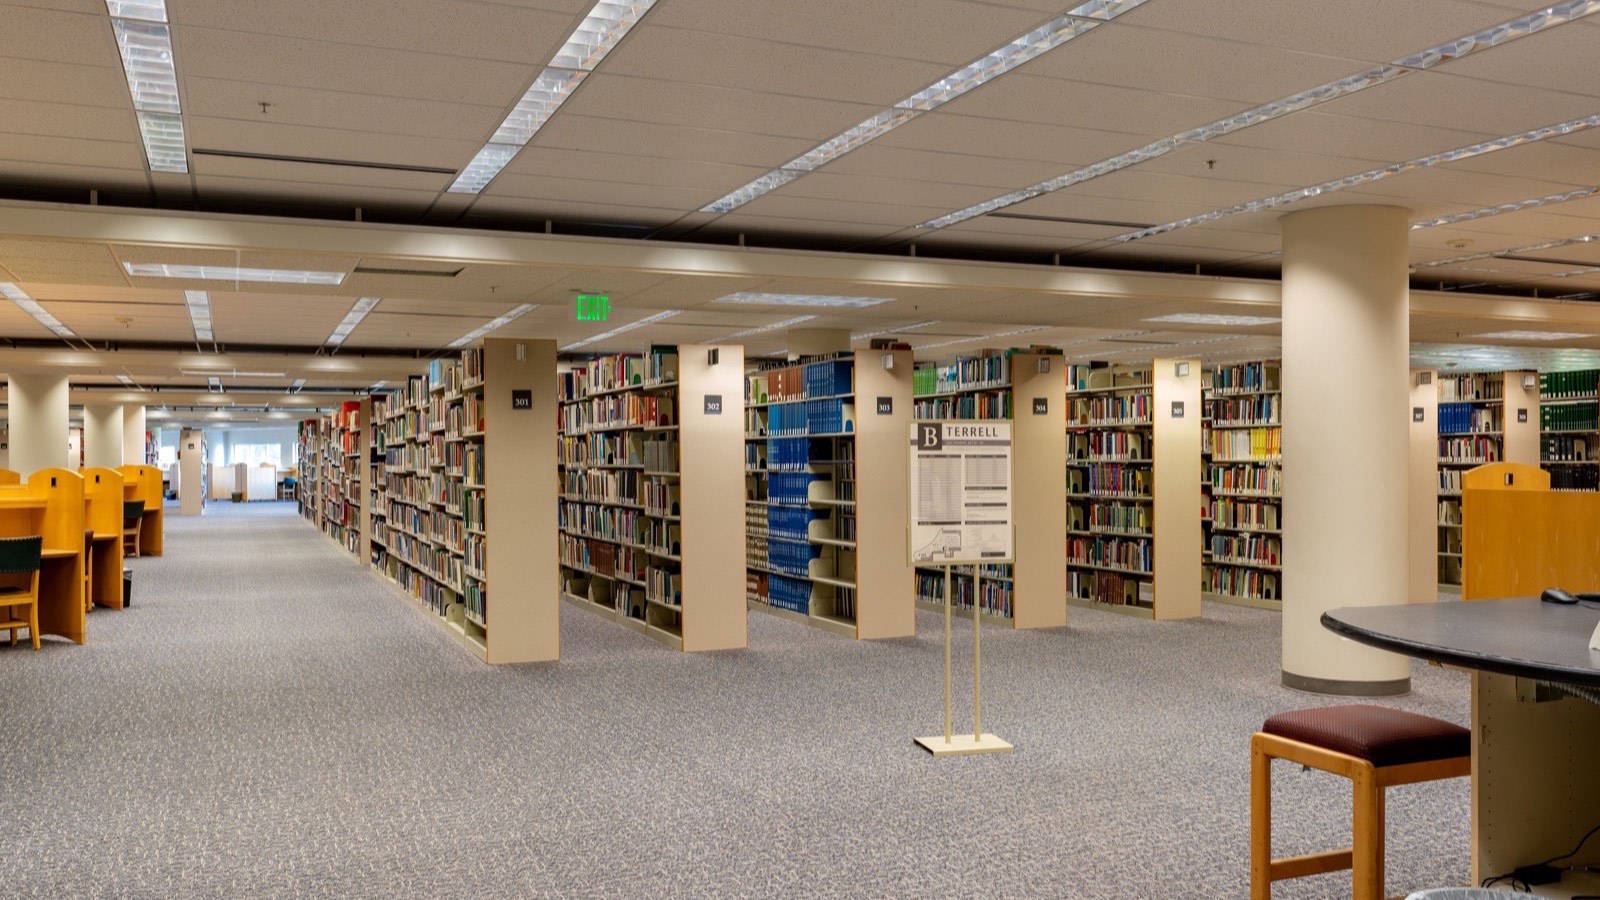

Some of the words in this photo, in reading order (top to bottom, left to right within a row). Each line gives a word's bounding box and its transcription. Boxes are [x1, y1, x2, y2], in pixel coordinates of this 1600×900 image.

[577, 295, 609, 321] EXIT
[515, 398, 529, 406] 301
[707, 403, 720, 411] 302
[924, 427, 938, 447] B
[946, 427, 998, 437] TERRELL
